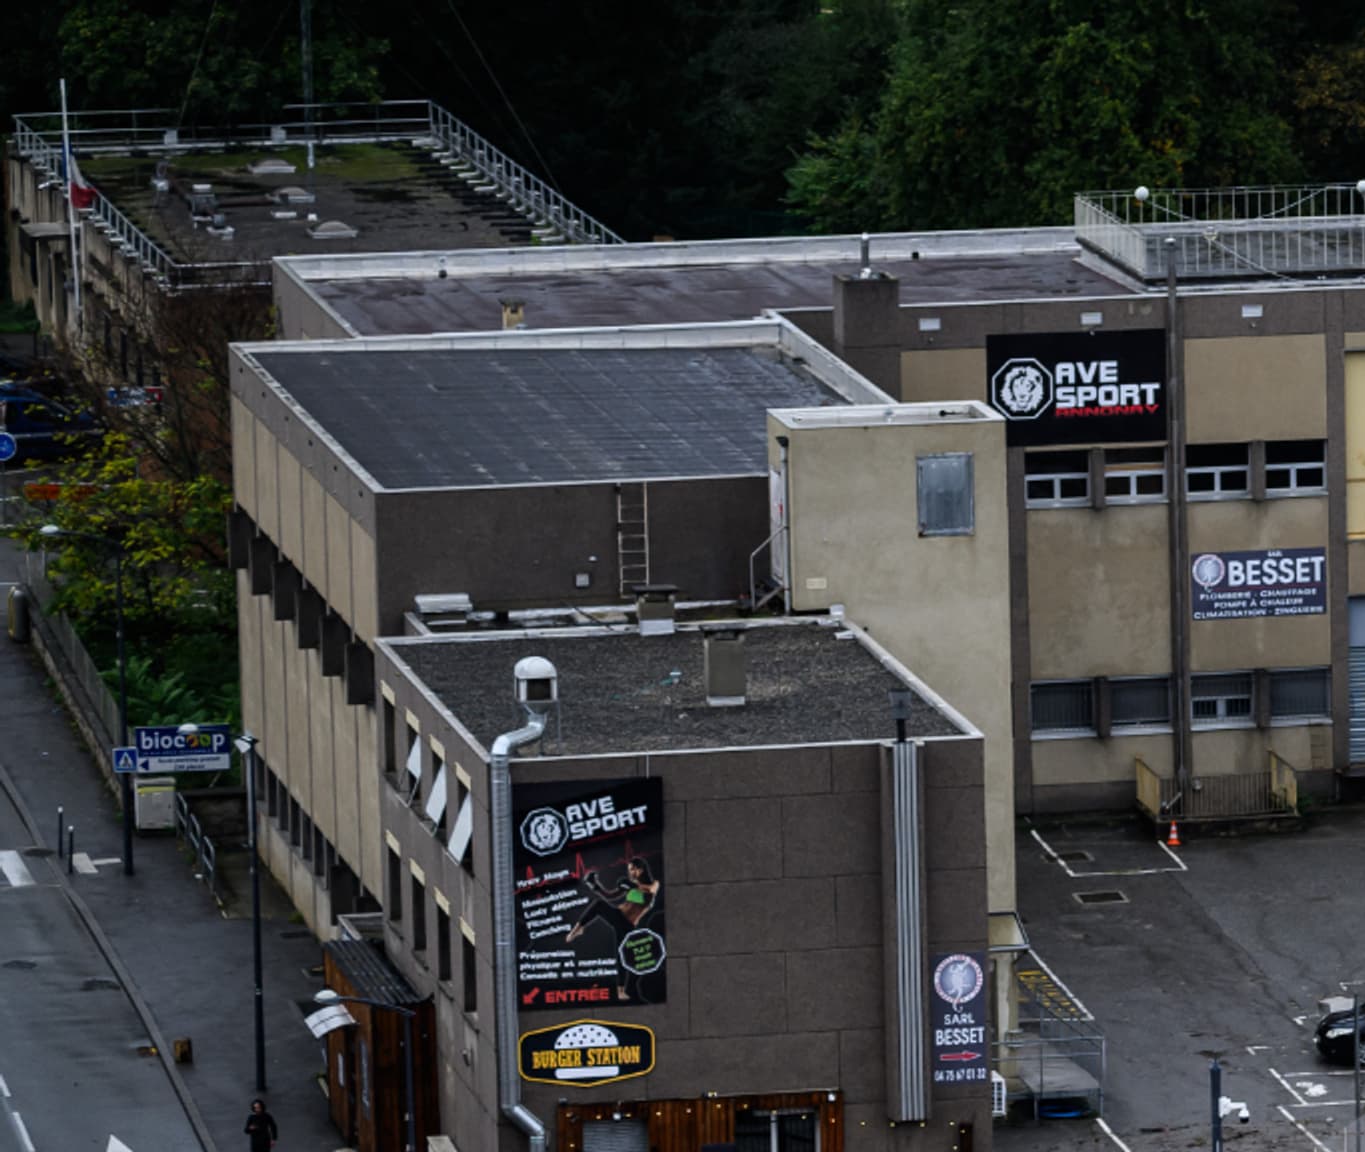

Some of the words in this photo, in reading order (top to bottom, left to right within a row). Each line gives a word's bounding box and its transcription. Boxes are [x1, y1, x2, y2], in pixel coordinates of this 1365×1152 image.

[1055, 360, 1118, 384] AVE
[1055, 383, 1161, 408] SPORT
[1055, 404, 1160, 417] ANNONAY
[1228, 556, 1325, 586] BESSET
[1200, 591, 1252, 601] PLOMBERIE
[1260, 588, 1317, 598] CHAUFFAGE
[1214, 600, 1247, 609] POMPE
[1260, 597, 1304, 607] CHALEUR
[1193, 608, 1267, 620] CLIMATISATION
[141, 730, 226, 753] biocoop
[565, 795, 615, 823] AVE
[570, 804, 648, 841] SPORT
[545, 984, 611, 1003] ENTRÉE
[944, 1012, 976, 1025] SARL
[935, 1026, 985, 1046] BESSET
[532, 1050, 582, 1070] BURGER
[586, 1045, 641, 1066] STATION
